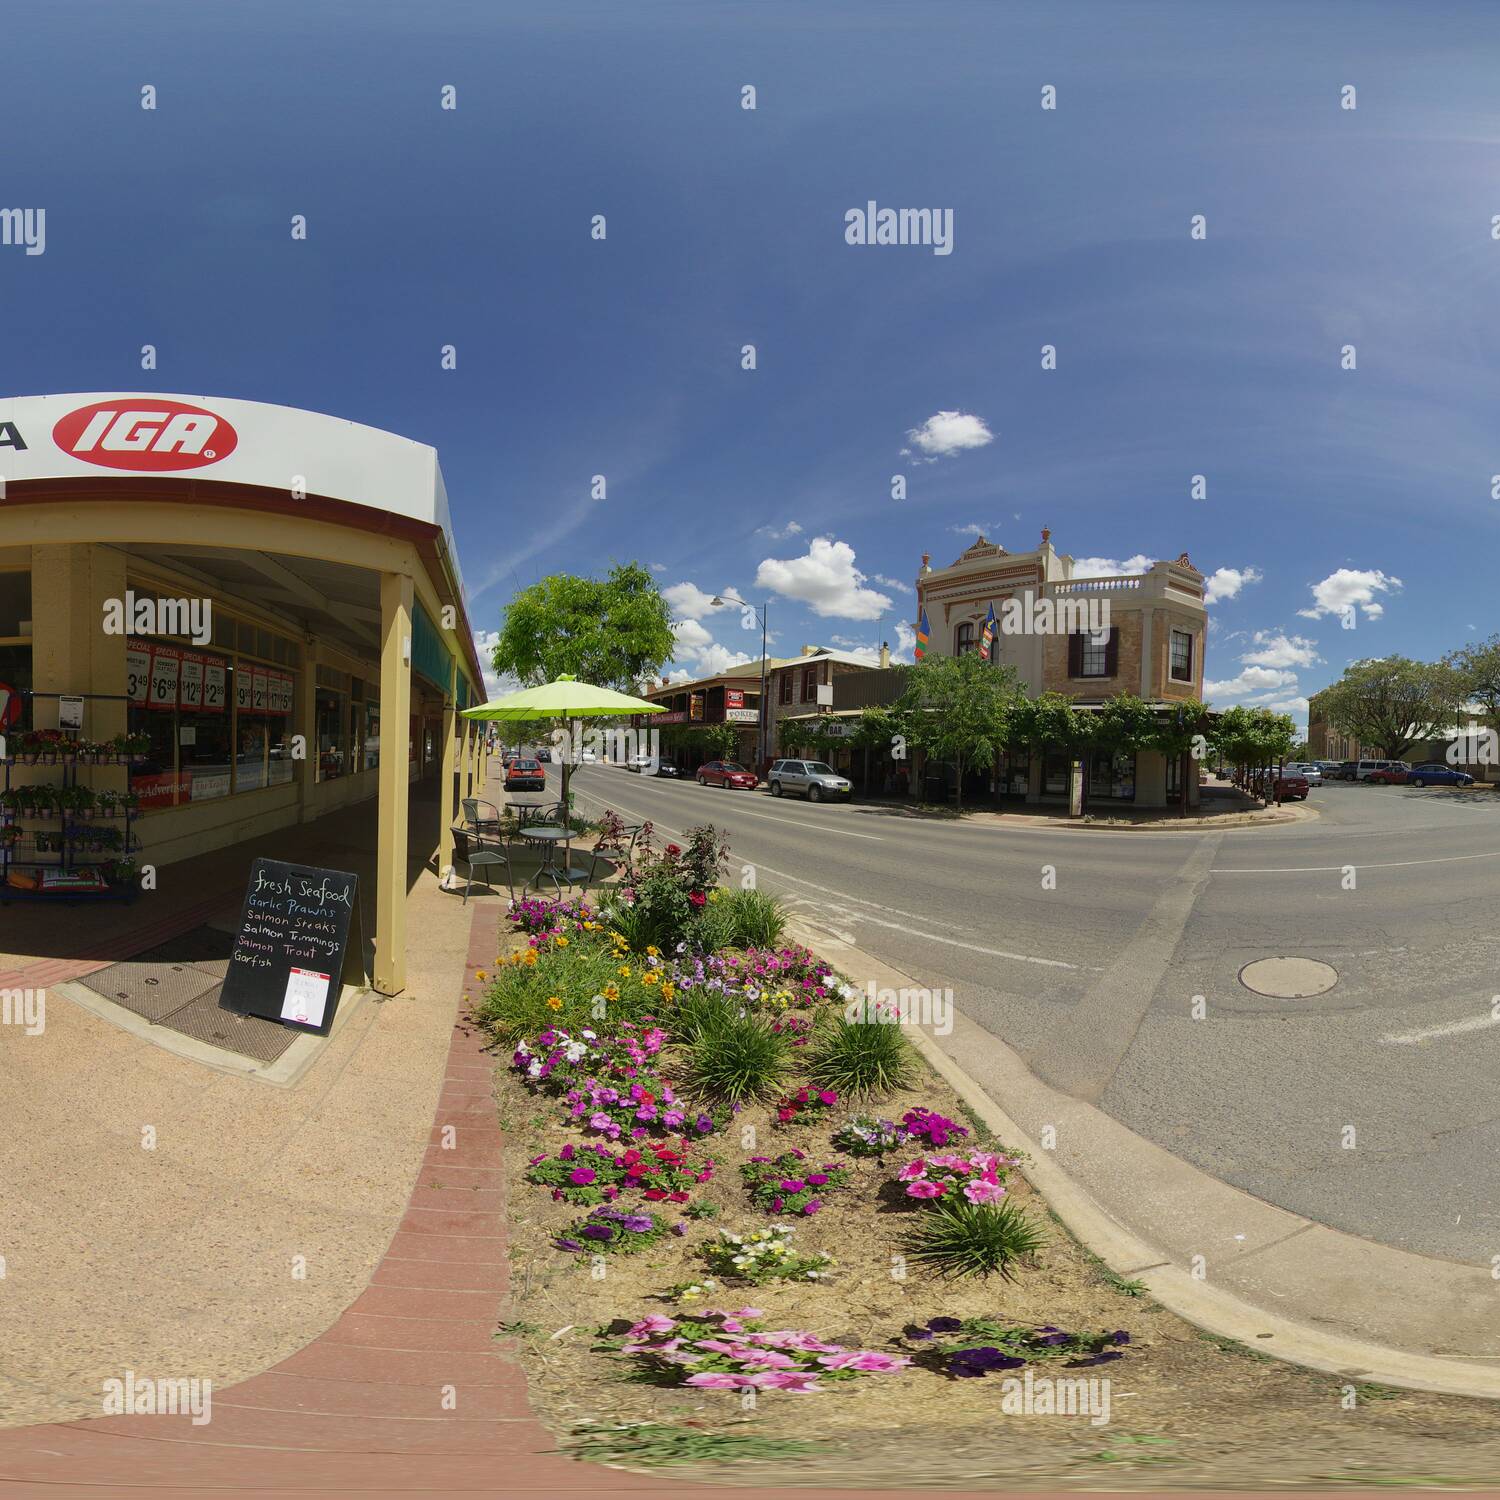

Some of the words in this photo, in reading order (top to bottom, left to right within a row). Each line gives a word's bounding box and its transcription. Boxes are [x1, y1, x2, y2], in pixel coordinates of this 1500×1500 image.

[72, 410, 218, 455] IGA
[127, 640, 150, 651] PECIAL
[156, 646, 178, 657] SPECIAL
[830, 726, 842, 735] BAR
[255, 869, 292, 895] fresh
[299, 878, 351, 907] Seafood
[249, 893, 282, 910] Garlic
[287, 899, 336, 917] Prawns
[243, 923, 284, 938] Salmon
[247, 909, 289, 925] Salmon
[295, 917, 337, 934] Steaks
[238, 935, 274, 953] Salmon
[283, 944, 318, 959] Trout
[234, 949, 272, 967] Garfish
